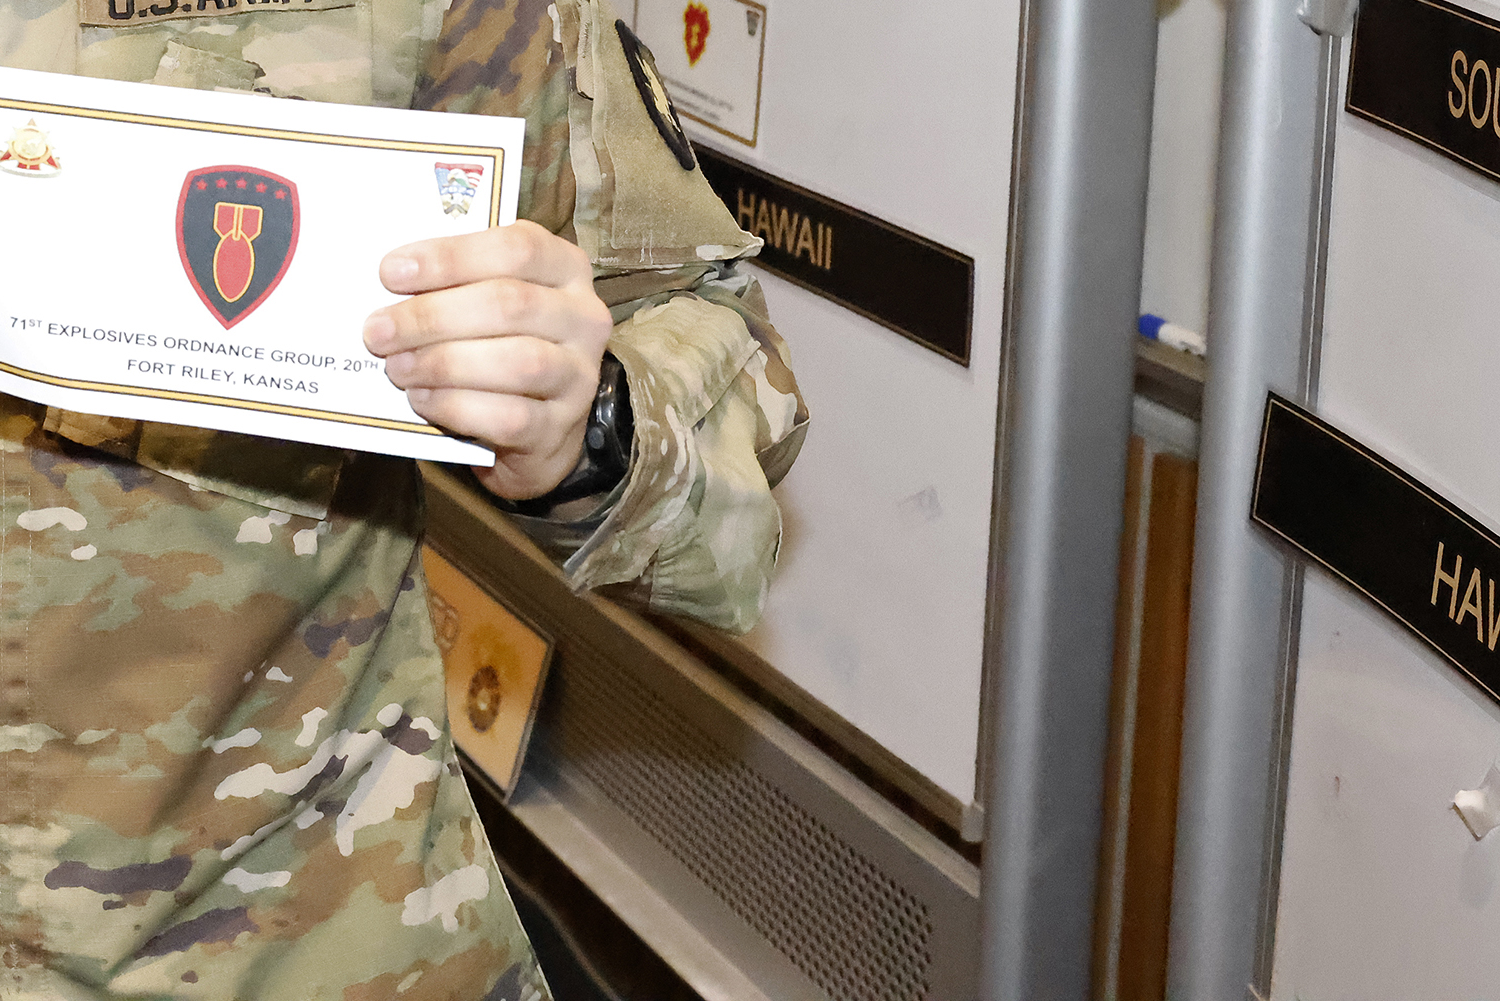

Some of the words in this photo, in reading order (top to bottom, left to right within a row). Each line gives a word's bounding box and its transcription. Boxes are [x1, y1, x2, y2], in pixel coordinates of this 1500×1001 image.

[737, 188, 833, 271] HAWAII
[10, 316, 42, 331] 71ST
[47, 322, 158, 348] EXPLOSIVES
[163, 336, 266, 360] ORDNANCE
[270, 349, 338, 371] GROUP,
[127, 359, 175, 376] FORT
[181, 366, 236, 385] RILEY,
[243, 373, 320, 394] KANSAS
